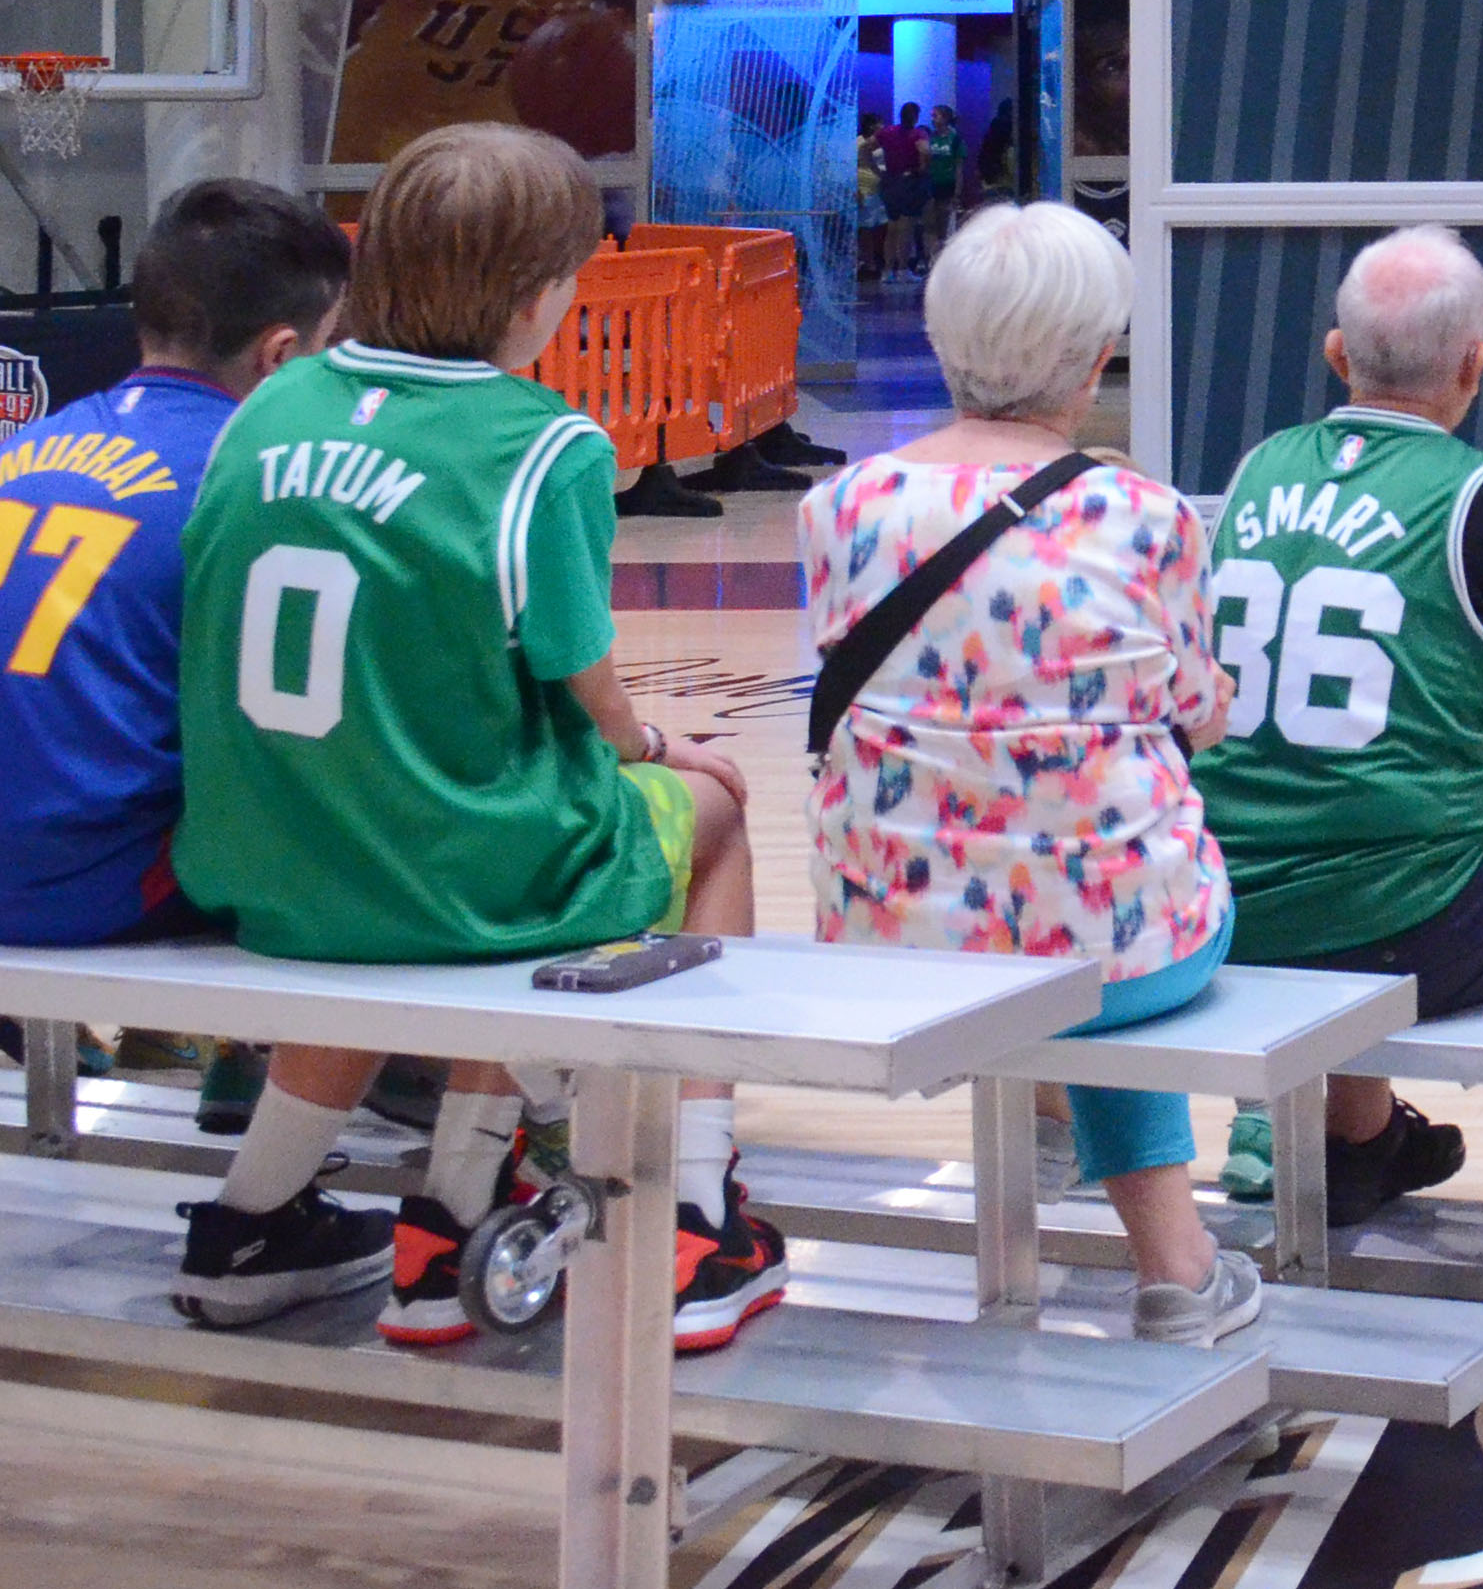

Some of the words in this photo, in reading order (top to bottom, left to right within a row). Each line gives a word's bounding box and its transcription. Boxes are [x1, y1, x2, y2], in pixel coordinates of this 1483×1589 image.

[0, 432, 178, 502] MURRAY
[258, 440, 427, 525] TATUM
[1235, 482, 1406, 557] SMART
[238, 543, 361, 740] 0
[1211, 558, 1406, 749] 36
